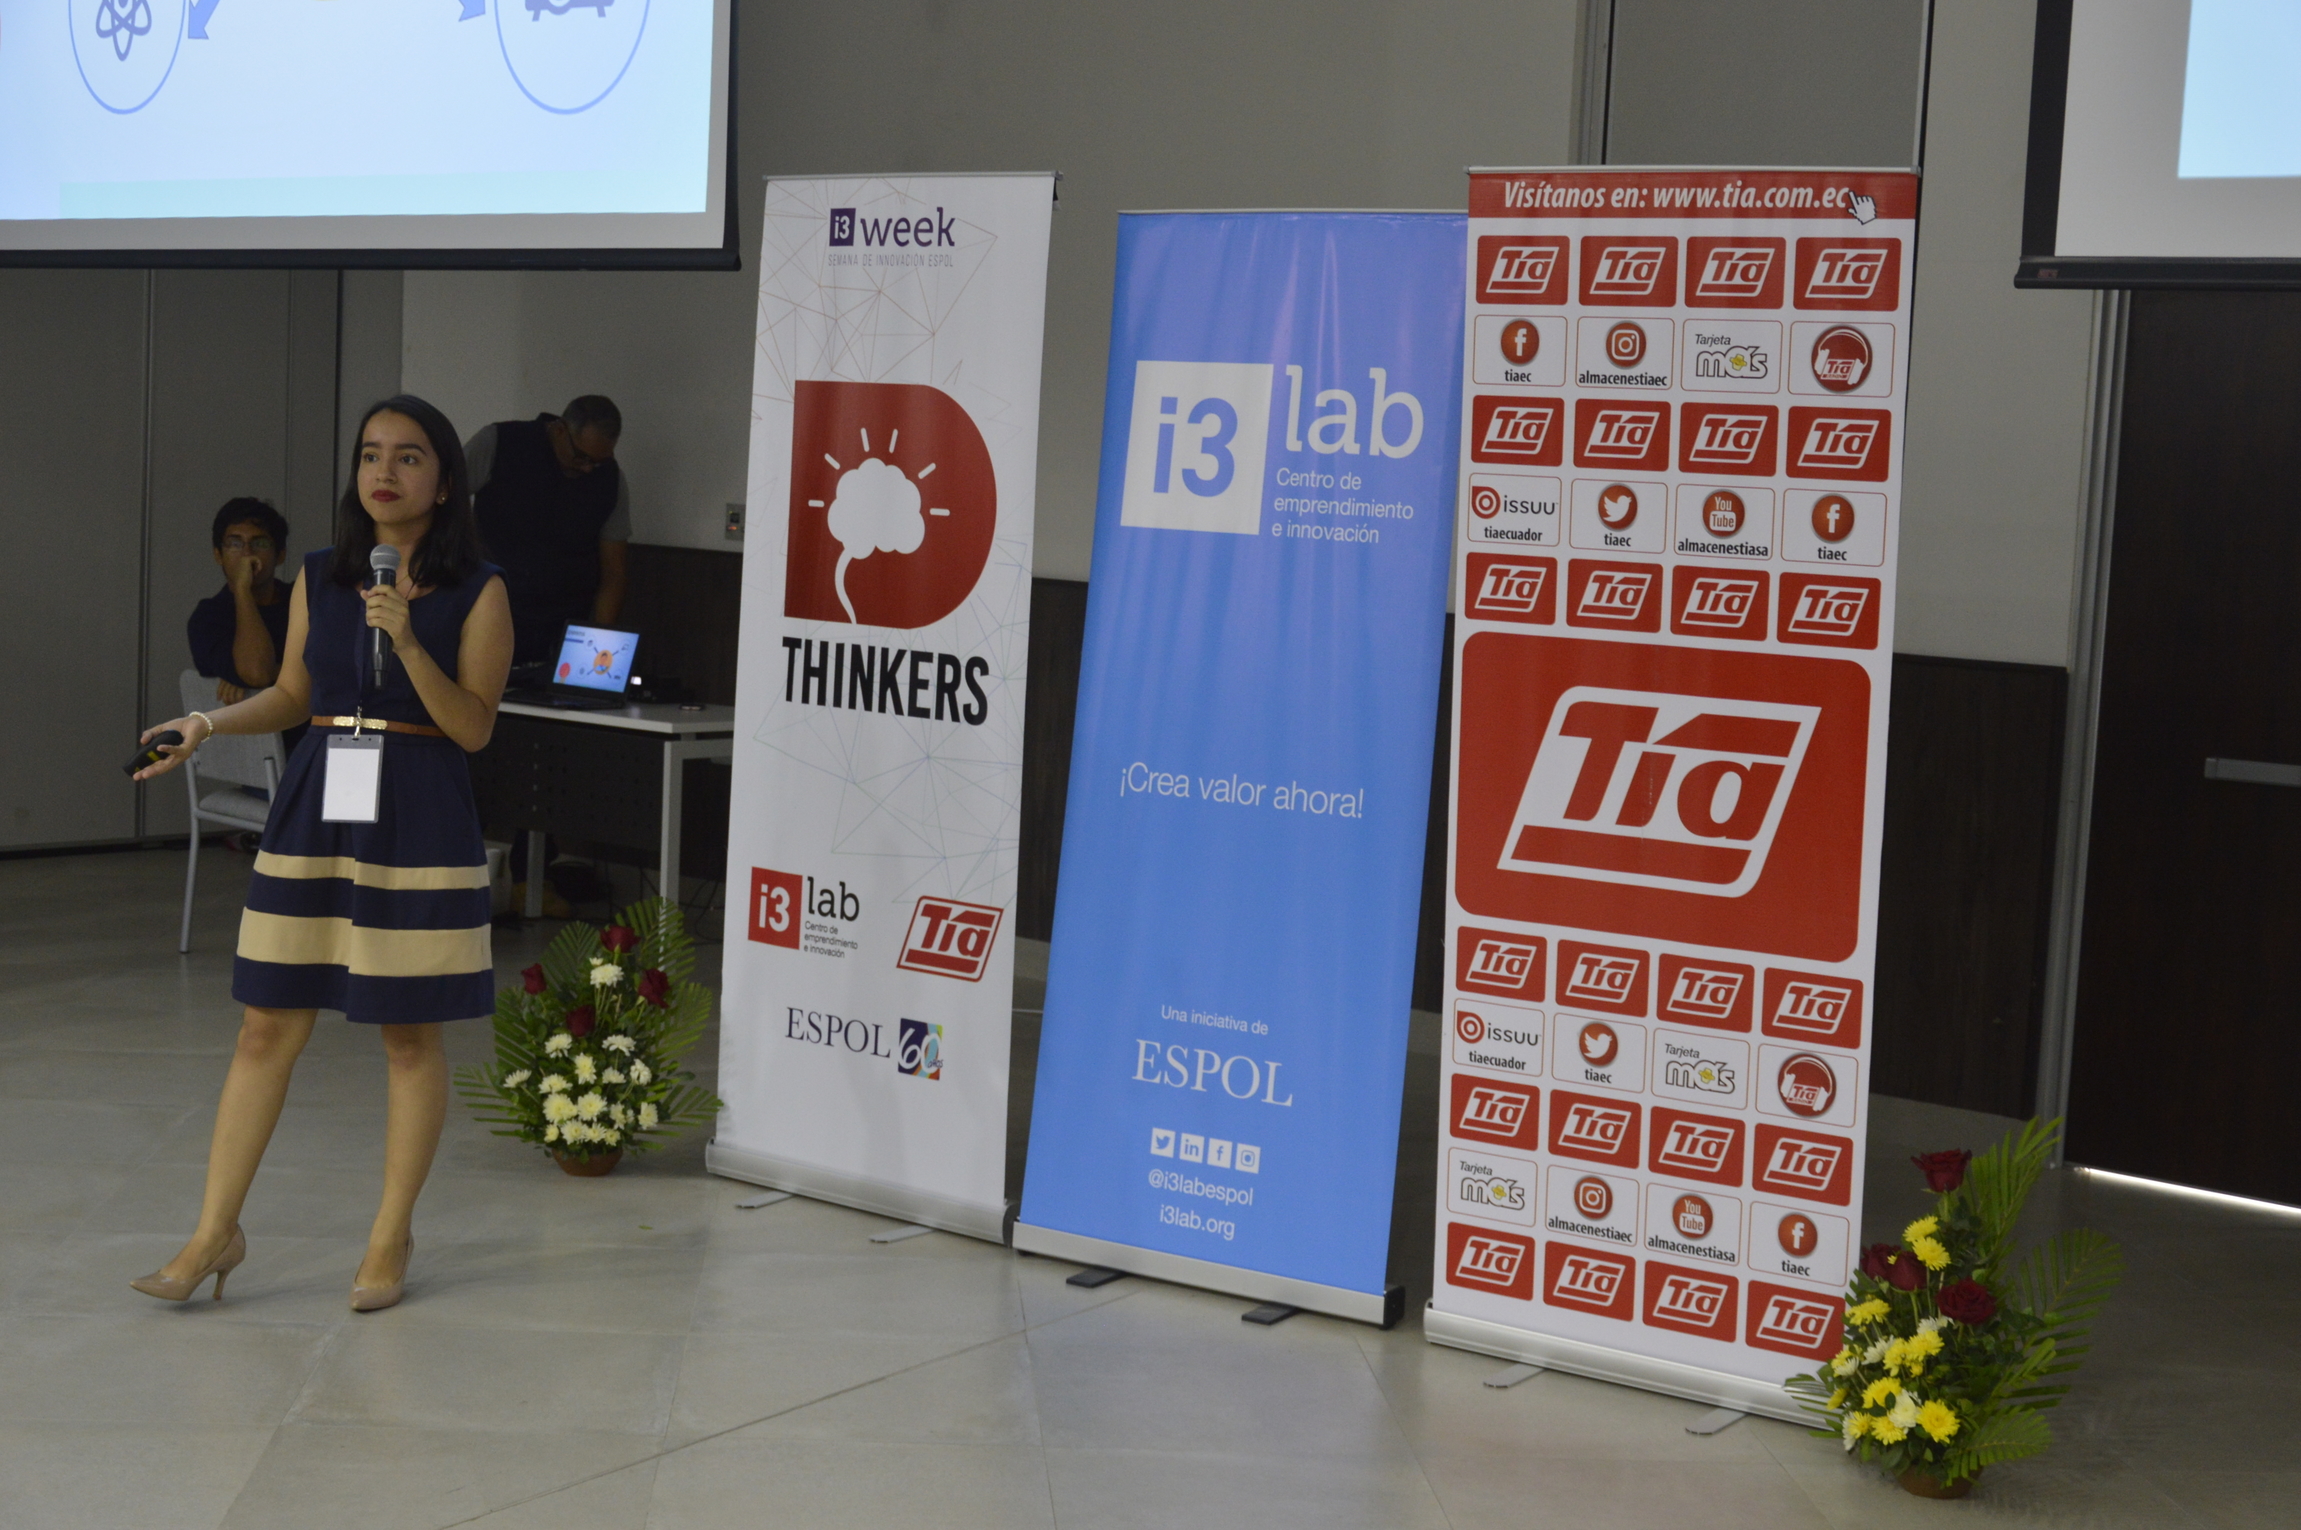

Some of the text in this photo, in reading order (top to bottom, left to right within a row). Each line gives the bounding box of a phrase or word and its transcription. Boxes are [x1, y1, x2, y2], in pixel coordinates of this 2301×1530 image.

[1504, 180, 1849, 209] Visítanos en: www.tia.com.ec
[860, 207, 956, 247] week
[828, 253, 954, 267] SEMANA DE INNOVACIÓN ESPOL
[1694, 333, 1732, 347] Tarjeta
[1504, 369, 1532, 383] tiaec
[1578, 370, 1668, 387] almacenestiaec
[1152, 364, 1424, 498] i3 lab
[1276, 467, 1362, 490] Centro de
[1274, 497, 1414, 520] emprendimiento
[1503, 494, 1556, 516] issuu
[1714, 496, 1732, 511] You
[1711, 513, 1735, 528] Tube
[1271, 519, 1379, 544] e innovación
[1484, 526, 1543, 542] tiaecuador
[1604, 533, 1632, 547] tiaec
[1678, 538, 1769, 557] almacenestiasa
[1817, 547, 1847, 561] tiaec
[782, 636, 989, 726] THINKERS
[1120, 762, 1364, 819] ¡Crea valor ahora!
[807, 876, 860, 922] lab
[804, 921, 839, 935] Centro de
[803, 944, 845, 958] e innovación
[804, 933, 858, 950] emprendimiento
[1161, 1004, 1269, 1036] Una iniciativa de
[785, 1007, 891, 1059] ESPOL
[1487, 1022, 1540, 1047] issuu
[1468, 1050, 1527, 1071] tiaecuador
[1664, 1043, 1700, 1059] Tarjeta
[1132, 1038, 1293, 1107] ESPOL
[1584, 1068, 1613, 1084] tiaec
[1459, 1160, 1493, 1176] Tarjeta
[1148, 1168, 1254, 1206] @i3labespol
[1684, 1199, 1702, 1215] You
[1159, 1204, 1236, 1241] i3lab.org
[1548, 1216, 1633, 1243] almacenestiaec
[1681, 1215, 1703, 1232] Tube
[1648, 1235, 1736, 1263] almacenestiasa
[1781, 1260, 1811, 1277] tiaec
